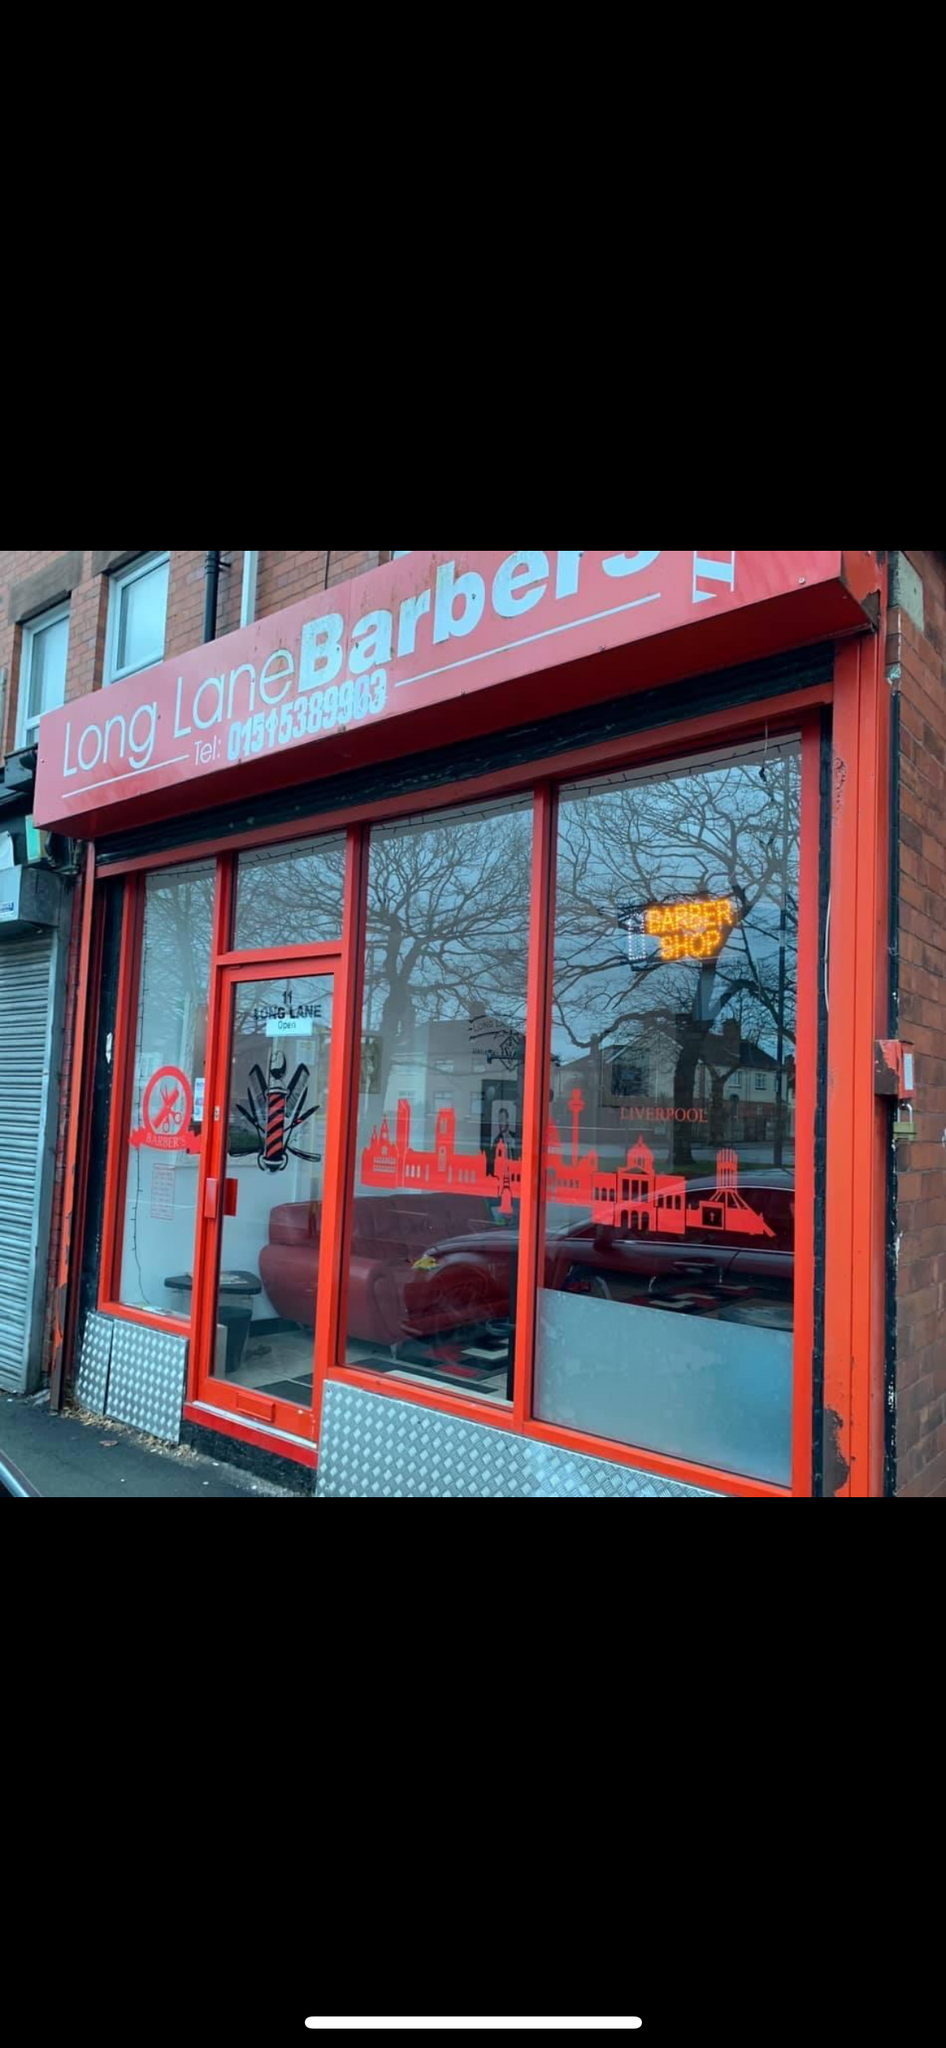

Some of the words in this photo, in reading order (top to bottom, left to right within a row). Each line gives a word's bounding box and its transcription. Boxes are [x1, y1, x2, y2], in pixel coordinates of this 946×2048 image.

[63, 701, 158, 778] Long
[194, 734, 222, 766] Tel:
[647, 898, 733, 935] BARBER
[659, 929, 723, 961] SHOP
[282, 990, 293, 1005] 11
[253, 1006, 286, 1021] LONG
[288, 1004, 322, 1019] LANE
[277, 1020, 297, 1031] Open
[619, 1106, 709, 1124] LIVERPOOL
